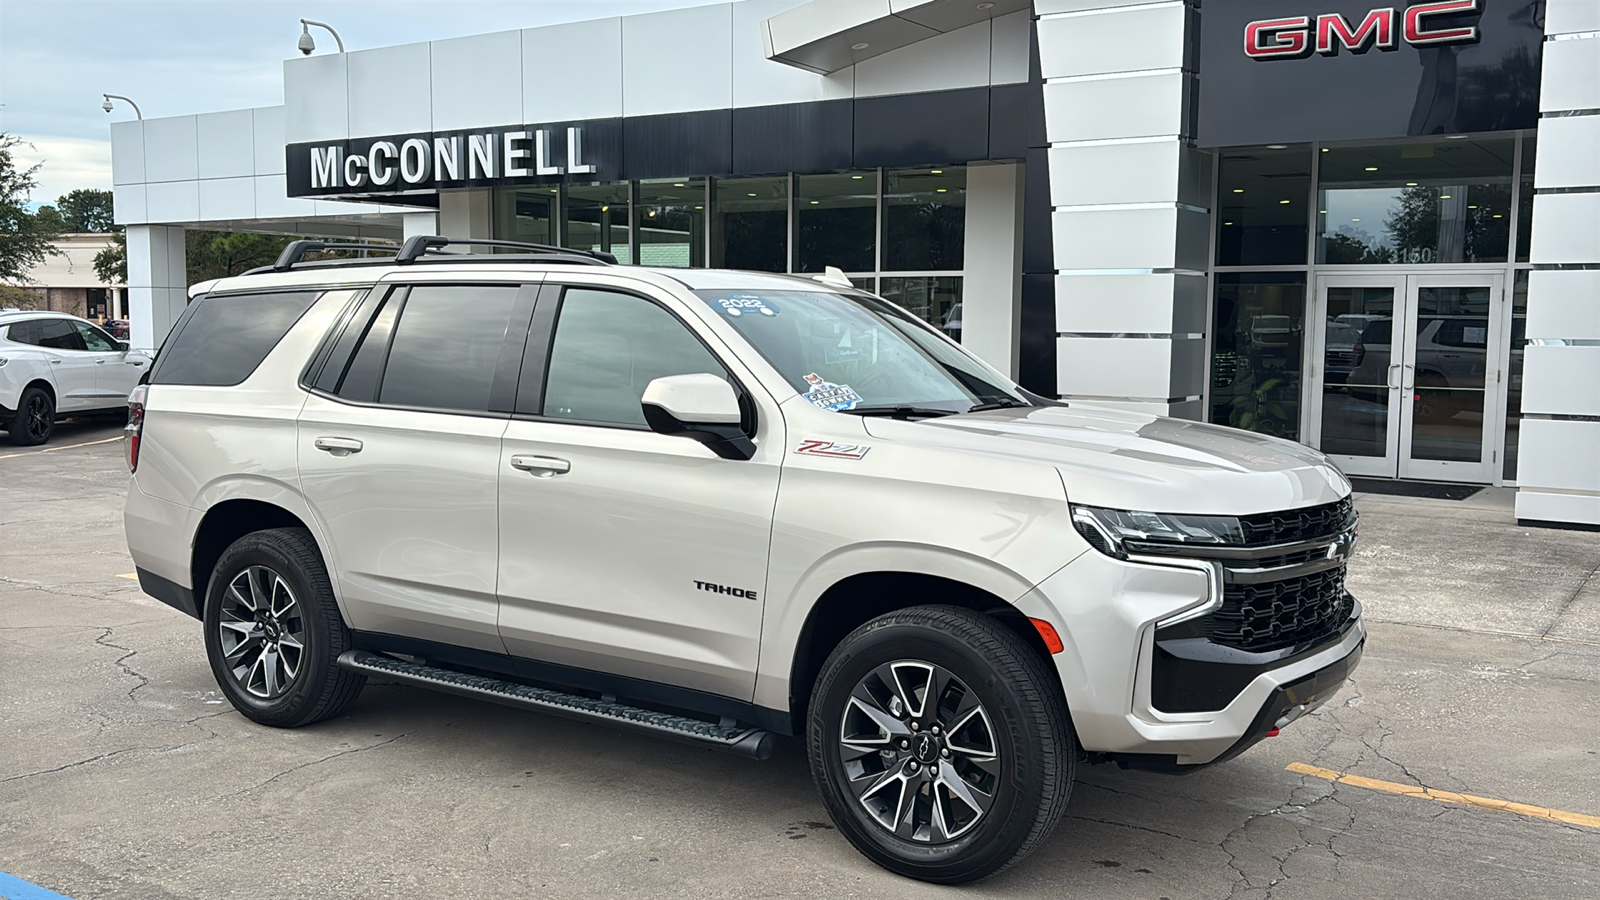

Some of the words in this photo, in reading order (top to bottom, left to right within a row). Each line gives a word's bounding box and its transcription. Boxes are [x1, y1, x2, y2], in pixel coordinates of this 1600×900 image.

[1244, 0, 1476, 58] GMC
[718, 299, 767, 308] 2022
[797, 440, 869, 455] Z71
[692, 579, 758, 601] TAHOE
